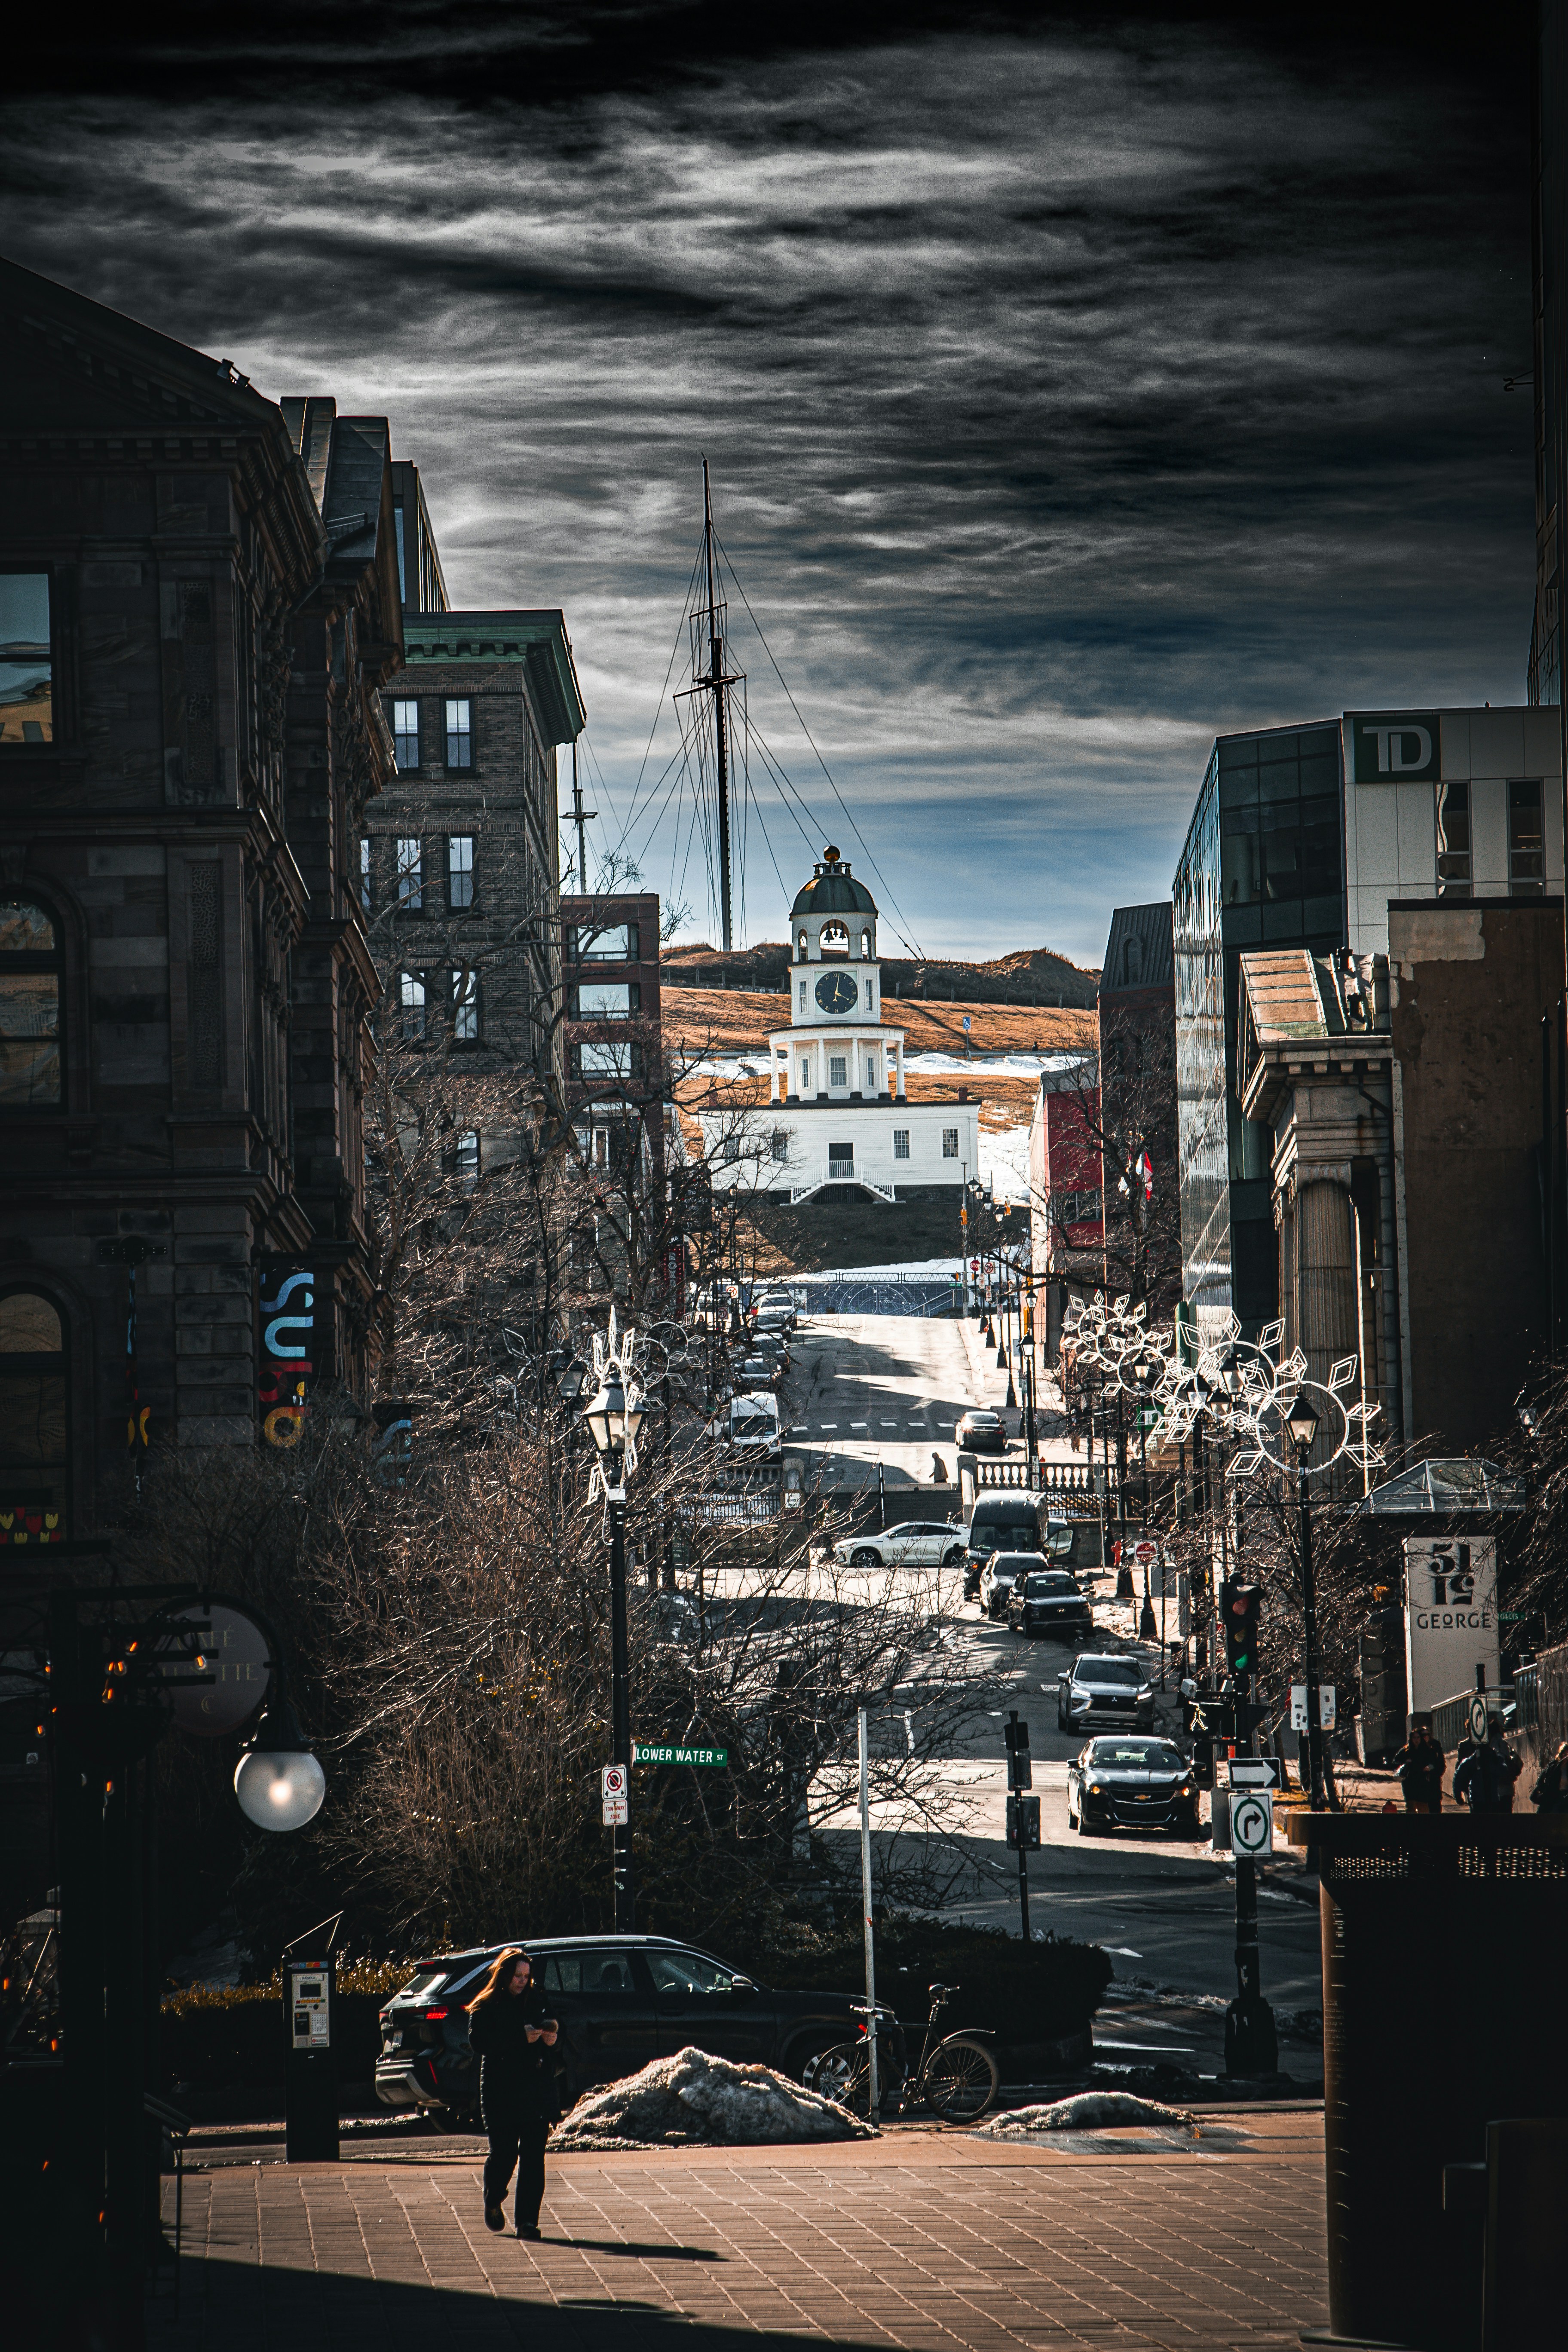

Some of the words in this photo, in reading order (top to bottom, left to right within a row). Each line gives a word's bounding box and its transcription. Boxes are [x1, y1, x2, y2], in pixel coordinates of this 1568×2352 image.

[1362, 725, 1432, 772] TD
[1417, 1613, 1491, 1629] GEORGE
[636, 1748, 672, 1761] LOWER
[676, 1749, 713, 1763] WATER
